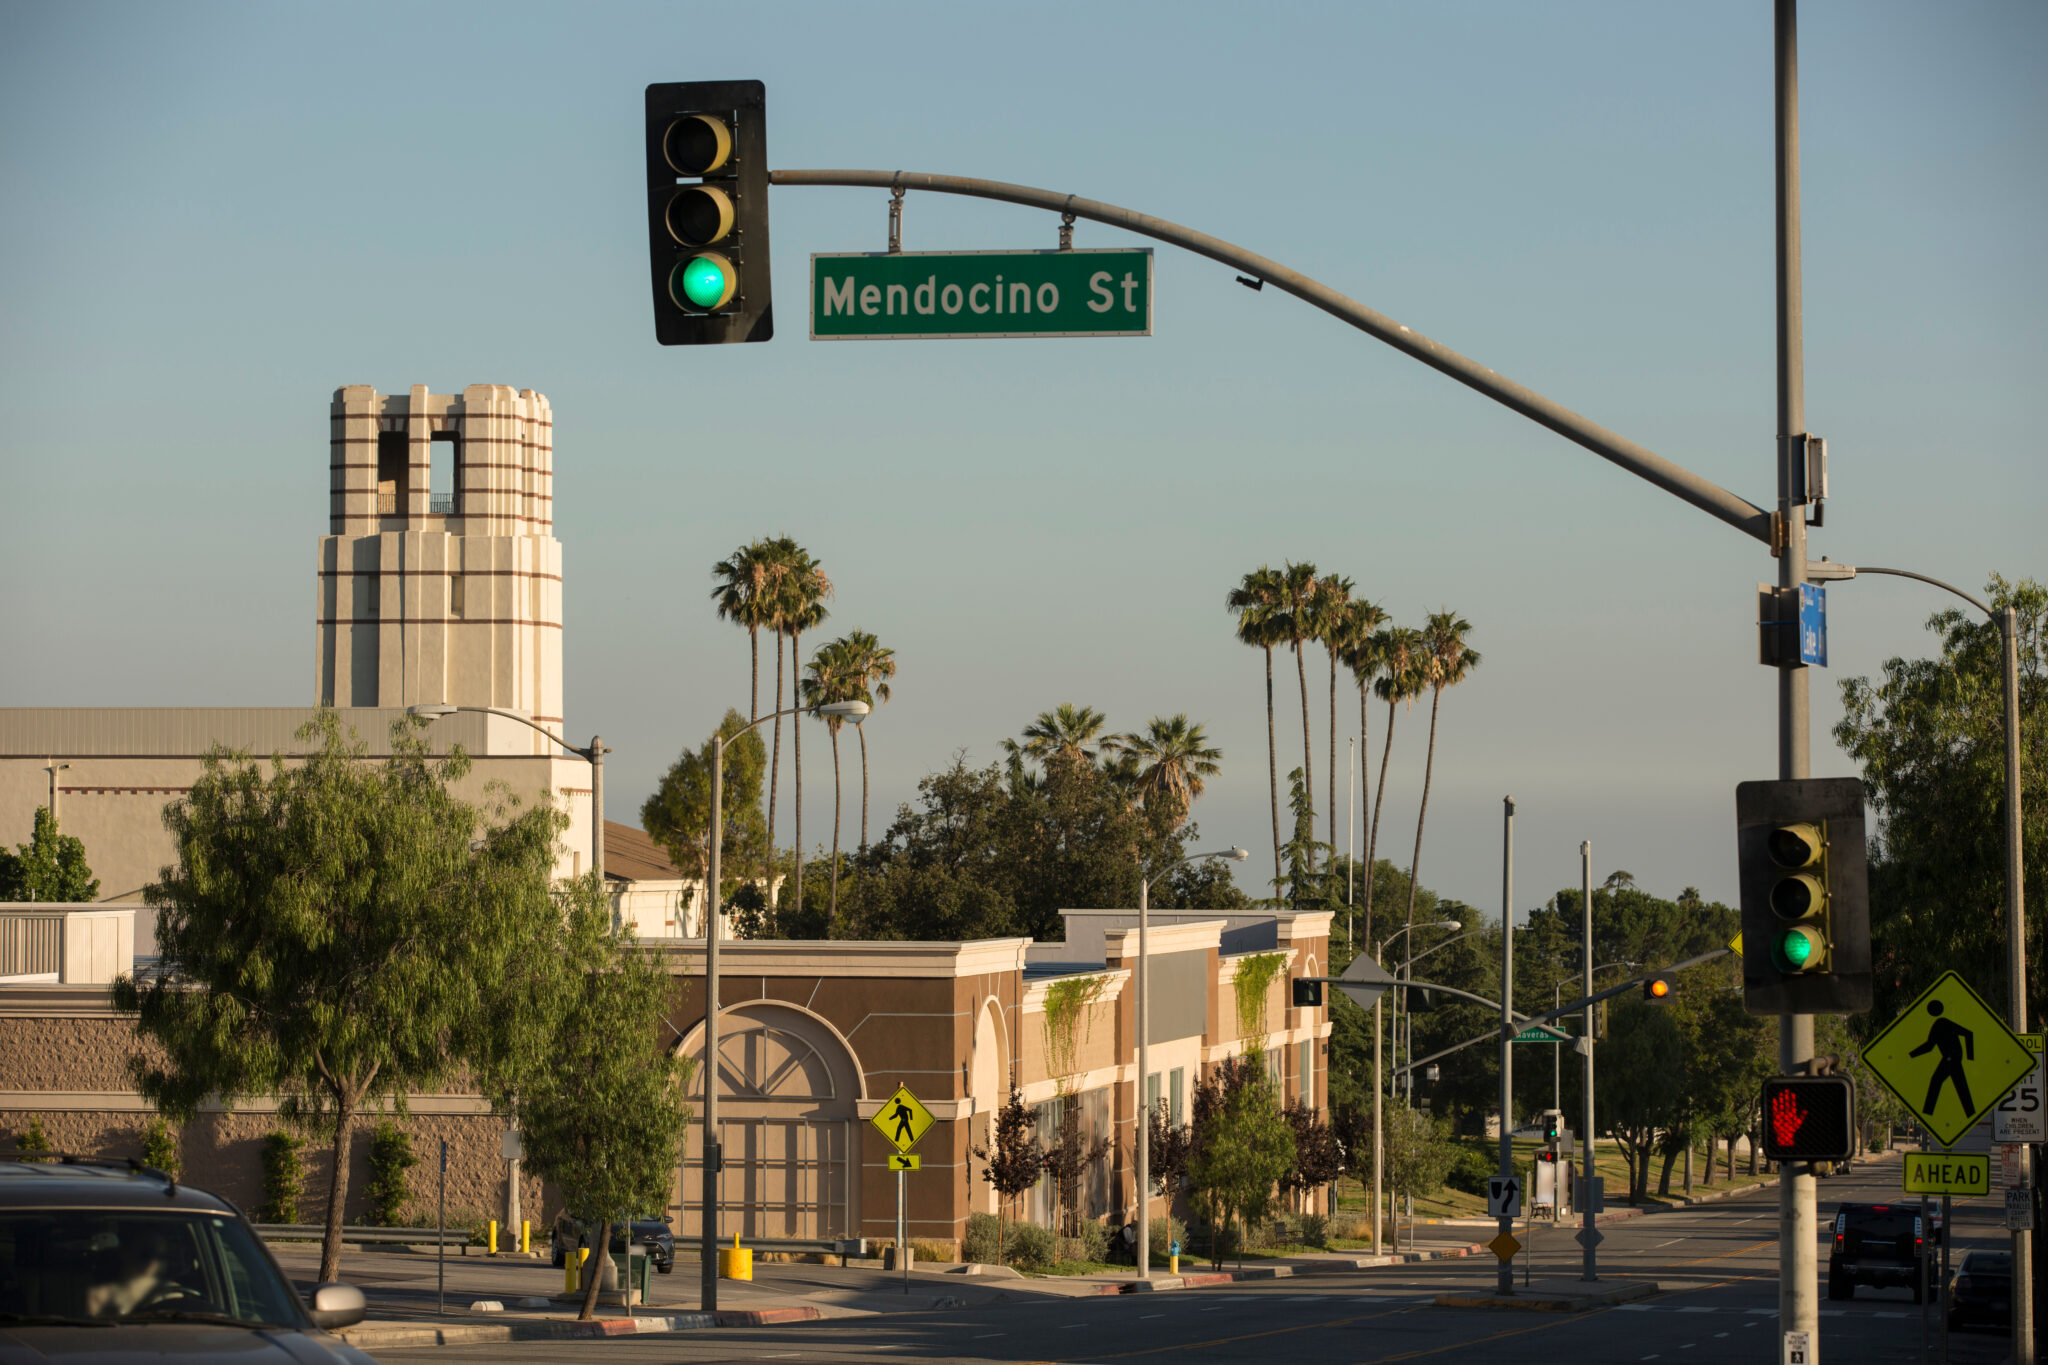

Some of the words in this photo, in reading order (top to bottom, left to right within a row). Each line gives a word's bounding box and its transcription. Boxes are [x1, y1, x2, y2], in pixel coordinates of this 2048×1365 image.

[823, 274, 1060, 317] Mendocino
[1086, 270, 1139, 314] St
[1998, 1088, 2040, 1112] 25
[1913, 1163, 1981, 1185] AHEAD
[2006, 1191, 2030, 1202] PARK
